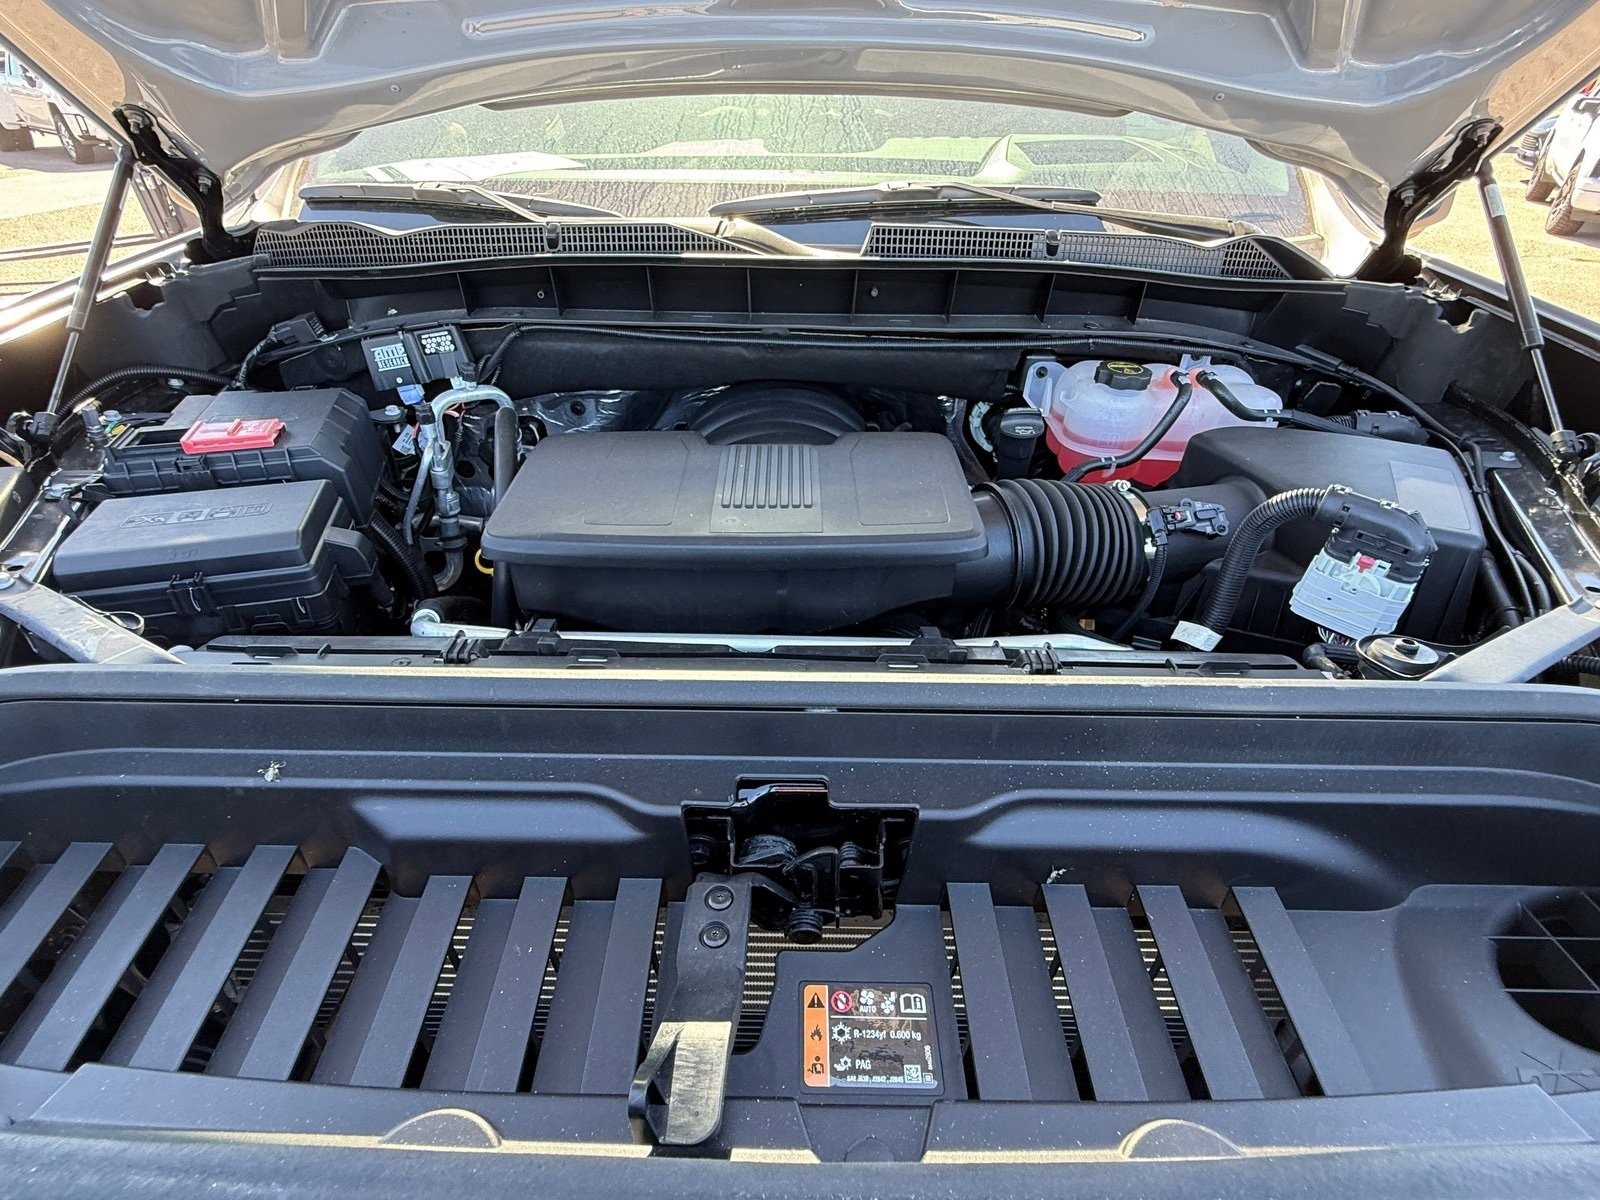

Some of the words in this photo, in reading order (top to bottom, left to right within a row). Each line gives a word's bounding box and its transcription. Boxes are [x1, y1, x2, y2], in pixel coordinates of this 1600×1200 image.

[860, 1005, 877, 1013] AUTO
[853, 1029, 886, 1040] R-1234yf
[889, 1030, 911, 1039] 0.600
[911, 1031, 922, 1041] kg
[855, 1059, 872, 1070] PAG
